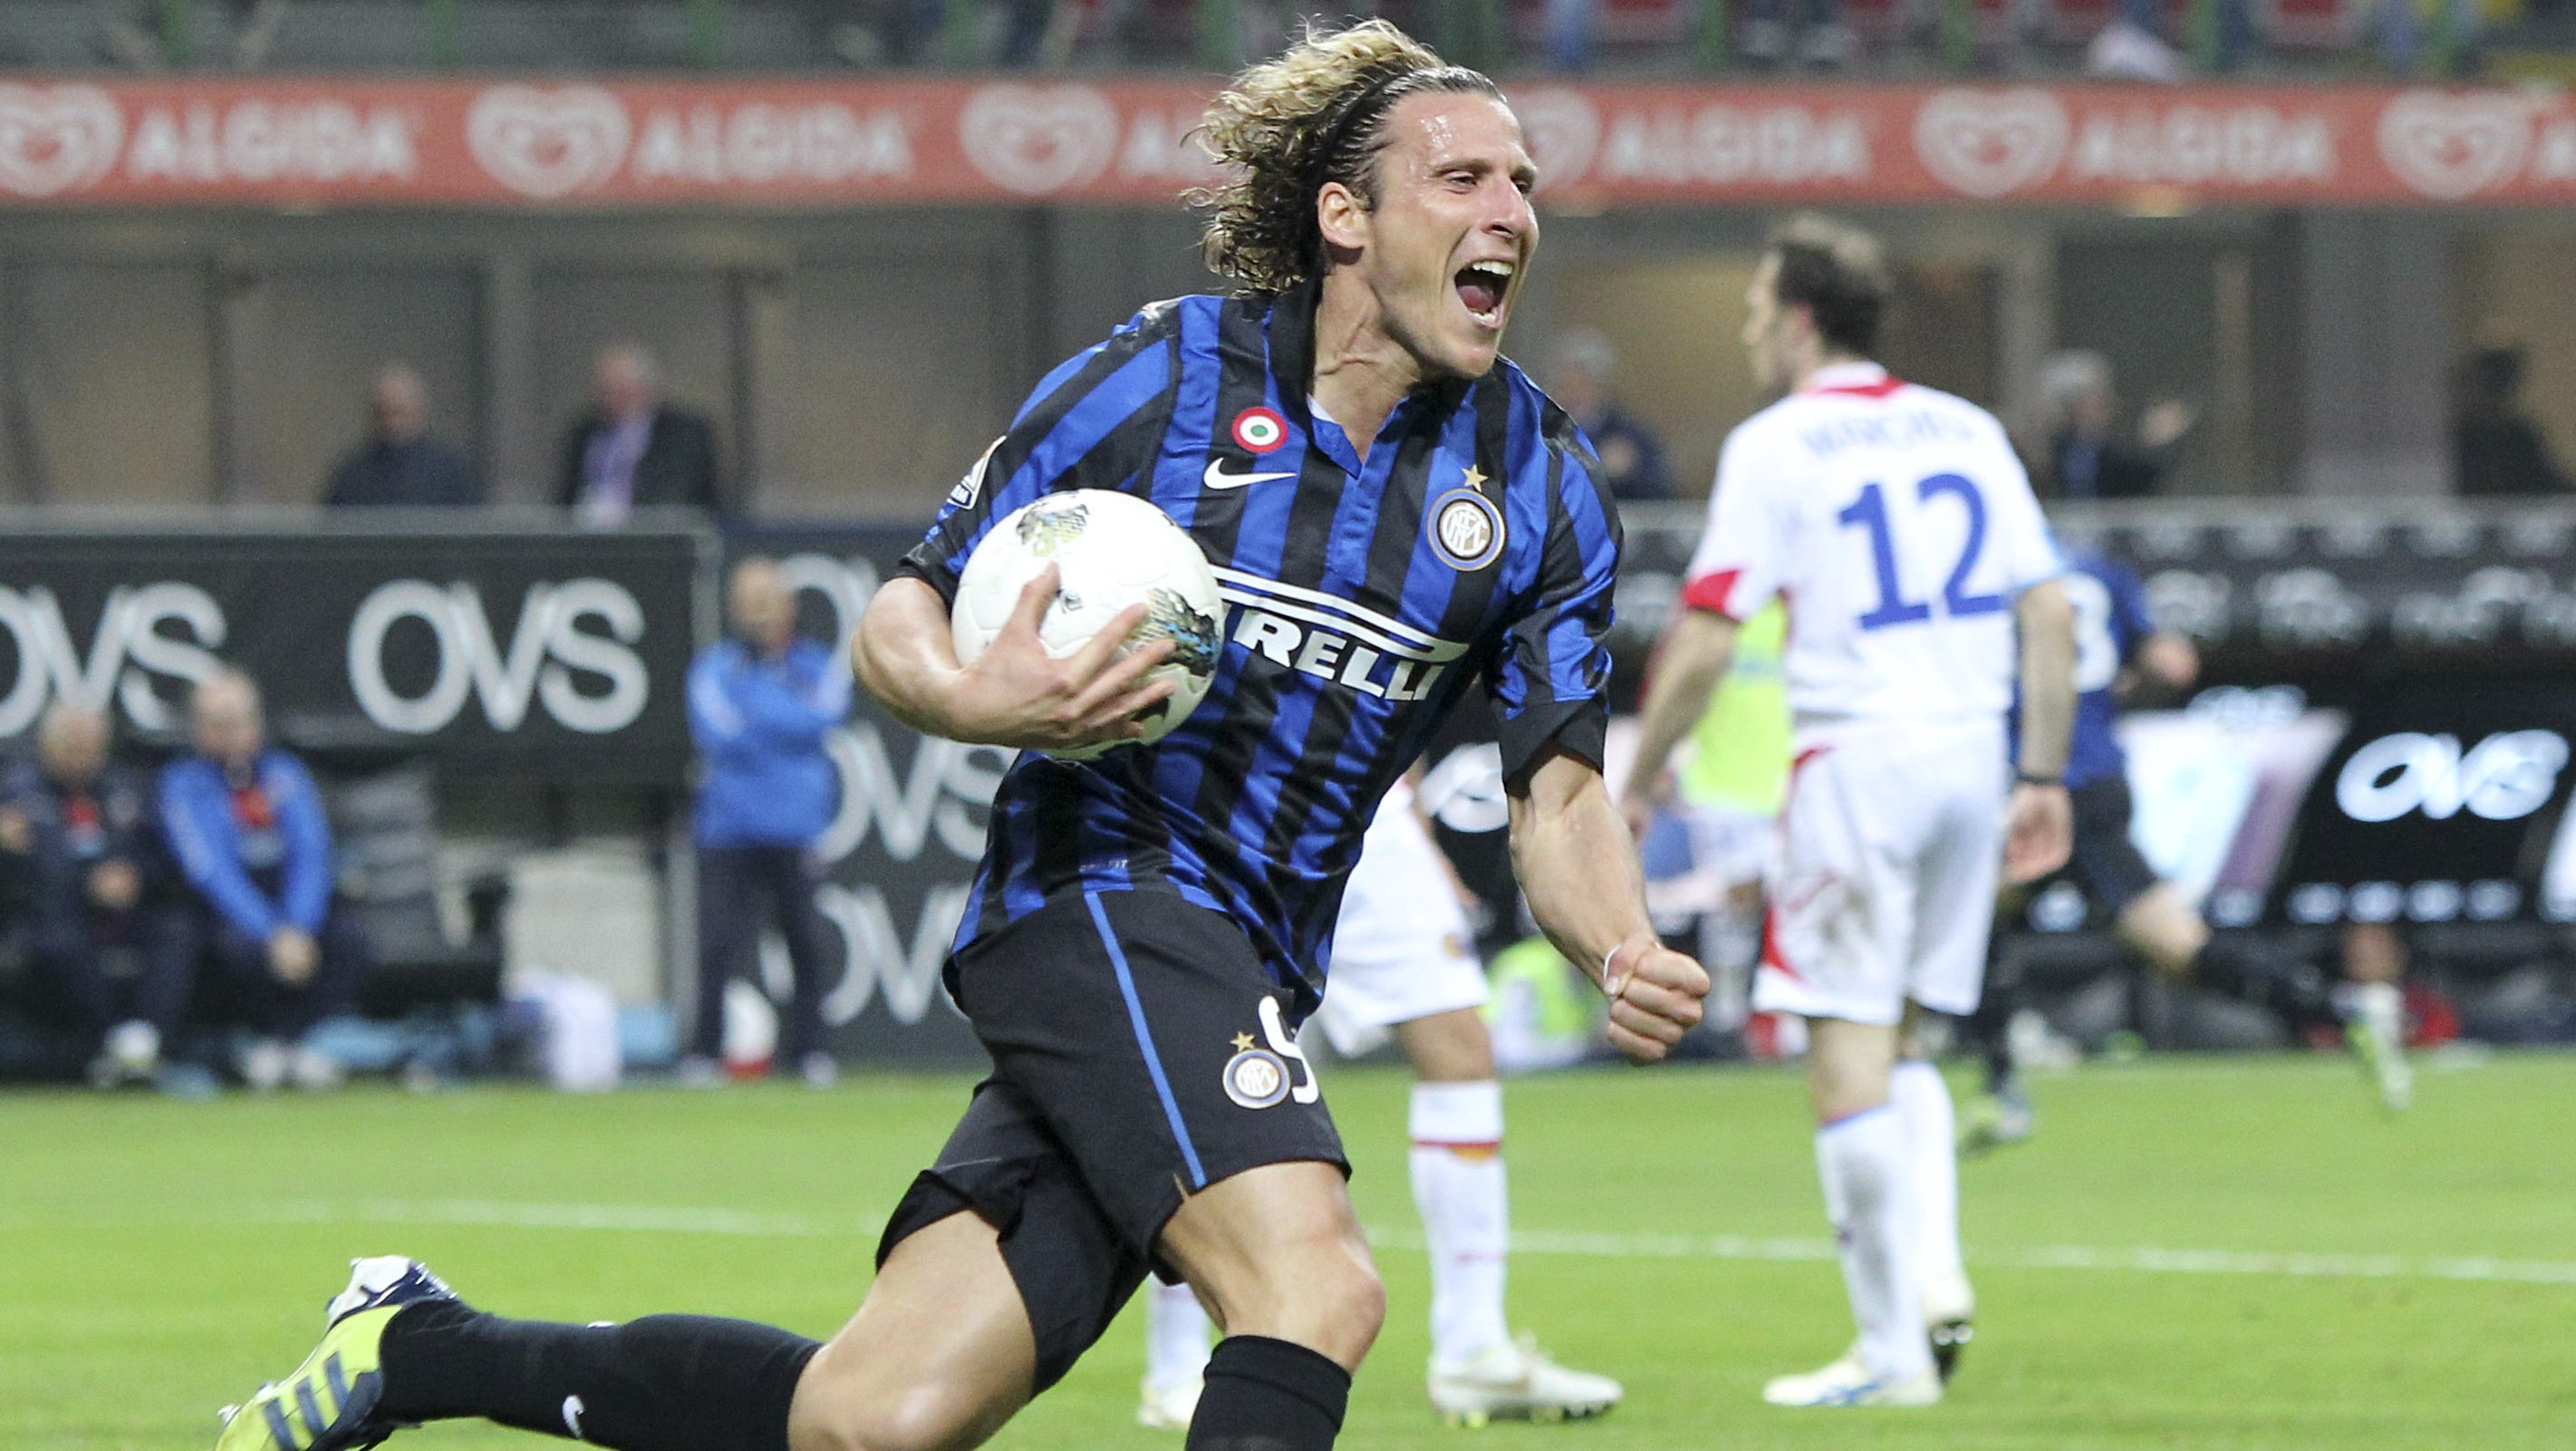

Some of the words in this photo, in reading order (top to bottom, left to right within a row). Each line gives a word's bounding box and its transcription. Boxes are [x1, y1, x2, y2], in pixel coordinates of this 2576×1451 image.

[127, 103, 417, 182] ALGIDA
[634, 103, 917, 182] ALGIDA
[1607, 103, 1870, 184] ALGIDA
[2073, 105, 2332, 184] ALGIDA
[1838, 473, 2010, 631] 12
[348, 578, 649, 733] OVS
[1218, 578, 1462, 701] PRELLI
[2336, 729, 2570, 822] OVS
[817, 884, 970, 1026] OV
